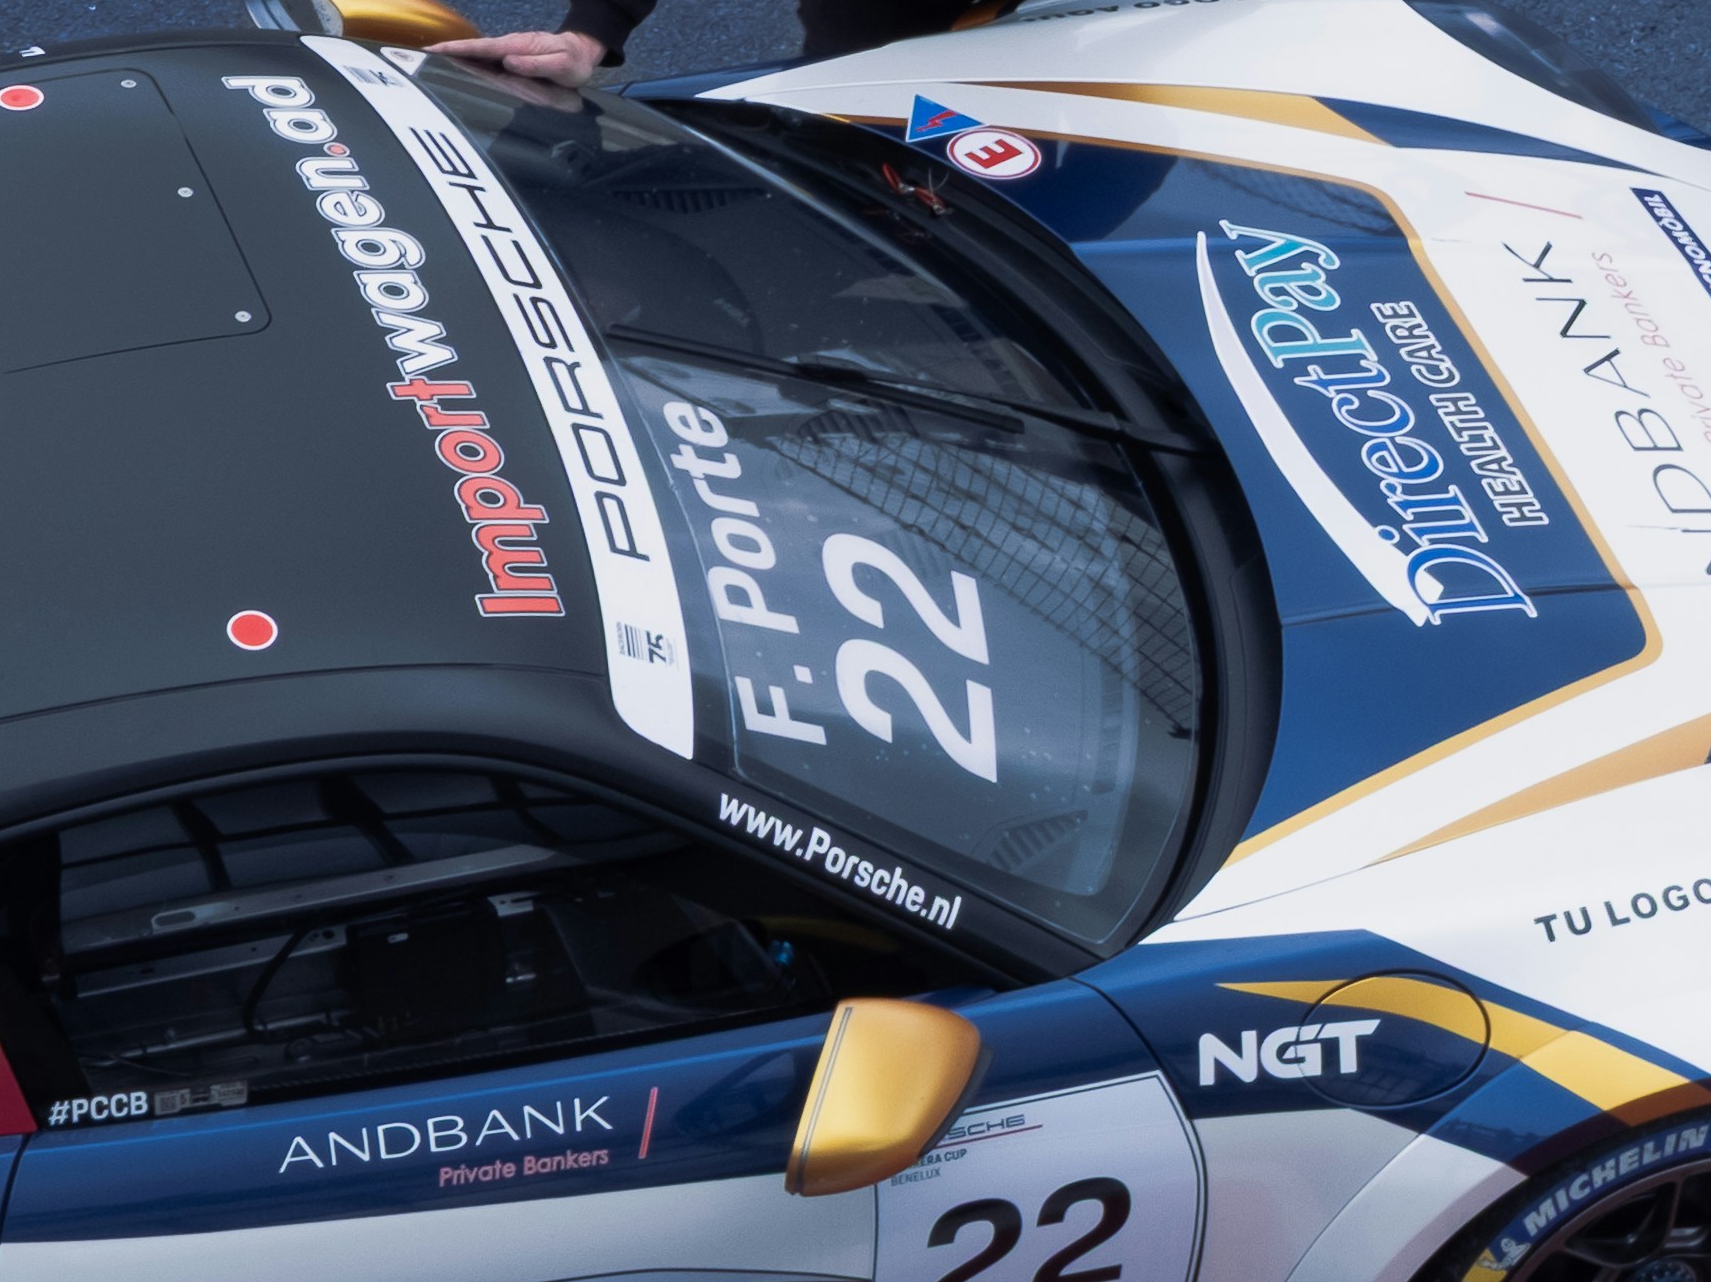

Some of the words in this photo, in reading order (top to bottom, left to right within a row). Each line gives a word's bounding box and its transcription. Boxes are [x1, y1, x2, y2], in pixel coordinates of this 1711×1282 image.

[964, 138, 1022, 170] E
[410, 126, 652, 564] PORSCHE
[1370, 299, 1462, 389] CARE
[1591, 251, 1671, 351] Bankers
[1219, 219, 1538, 625] DirectPay
[1429, 392, 1549, 527] HEALTH
[663, 400, 800, 635] Porte
[821, 533, 997, 784] 22
[718, 792, 962, 930] www.Porsche.nl
[1533, 905, 1594, 945] TU
[1199, 1019, 1381, 1086] NGT
[48, 1091, 149, 1127] #PCCB
[278, 1095, 613, 1174] ANDBANK
[438, 1157, 517, 1188] Private
[523, 1148, 610, 1176] Bankers
[1522, 1123, 1710, 1237] MICHELIN
